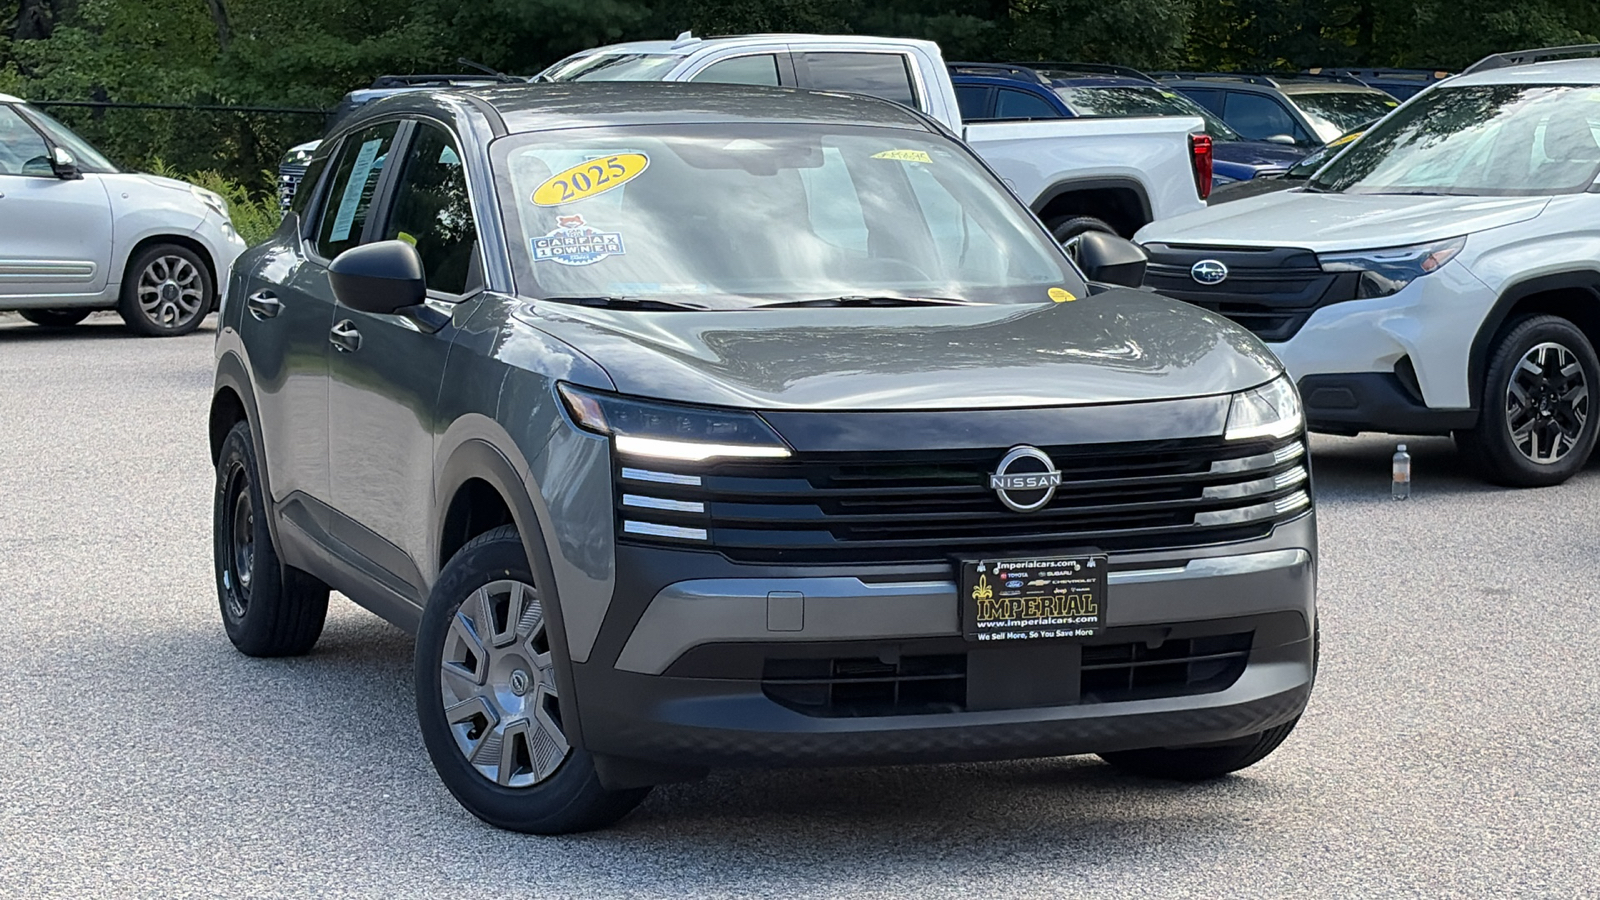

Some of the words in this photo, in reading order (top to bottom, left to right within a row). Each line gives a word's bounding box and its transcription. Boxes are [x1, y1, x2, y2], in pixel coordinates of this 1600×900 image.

[552, 157, 626, 201] 2025
[537, 236, 615, 248] CARFAX
[553, 244, 617, 254] OWNER
[992, 475, 1061, 488] NISSAN
[997, 560, 1077, 570] Imperialcars.com
[977, 594, 1098, 621] IMPERIAL
[977, 616, 1098, 628] www.imperialcars.com
[978, 633, 990, 641] We
[991, 632, 1005, 640] Sell
[1006, 632, 1028, 640] More,
[1029, 631, 1039, 639] So
[1040, 630, 1055, 638] You
